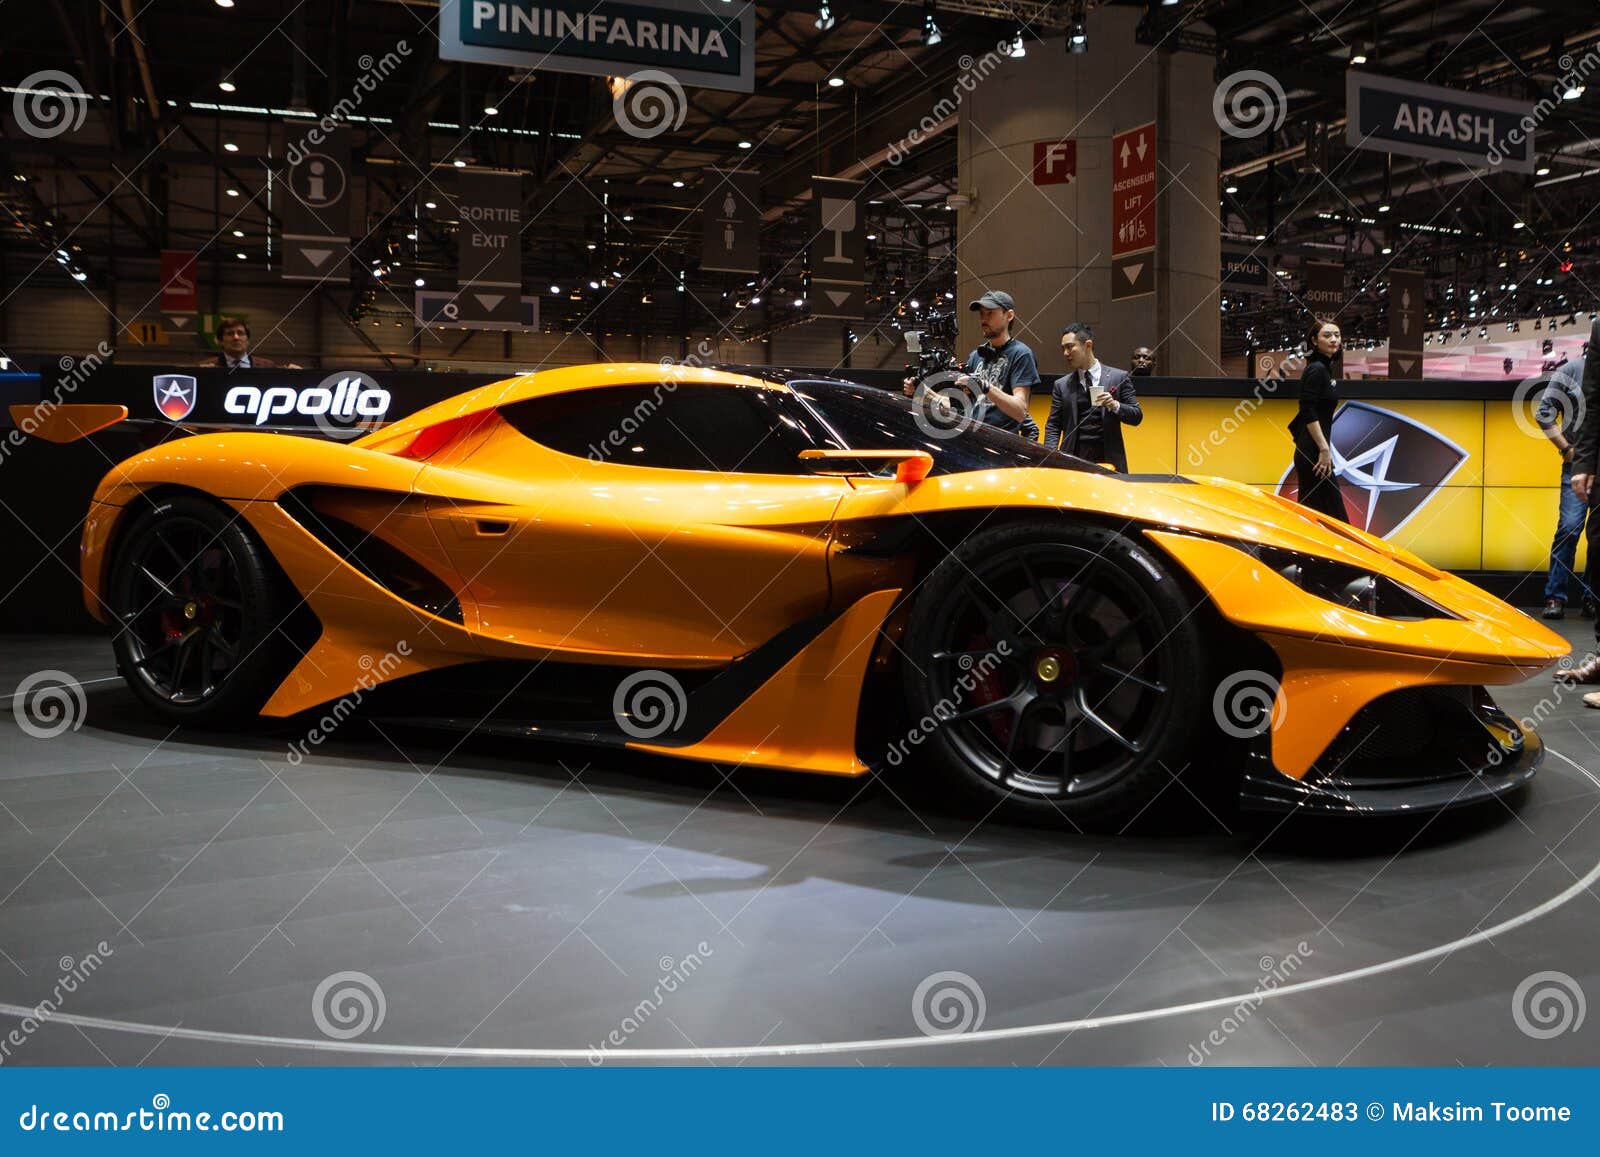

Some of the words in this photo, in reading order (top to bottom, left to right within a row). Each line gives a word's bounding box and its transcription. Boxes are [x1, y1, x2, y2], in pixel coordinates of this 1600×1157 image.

[473, 0, 728, 58] PININFARINA
[1393, 102, 1496, 147] ARASH
[1045, 144, 1068, 174] F
[1113, 171, 1155, 193] ASCENSEUR
[1124, 194, 1143, 211] LIFT
[459, 205, 521, 223] SORTIE
[472, 233, 509, 248] EXIT
[1227, 261, 1261, 274] REVUE
[1307, 289, 1344, 304] SORTIE
[223, 377, 392, 426] apollo
